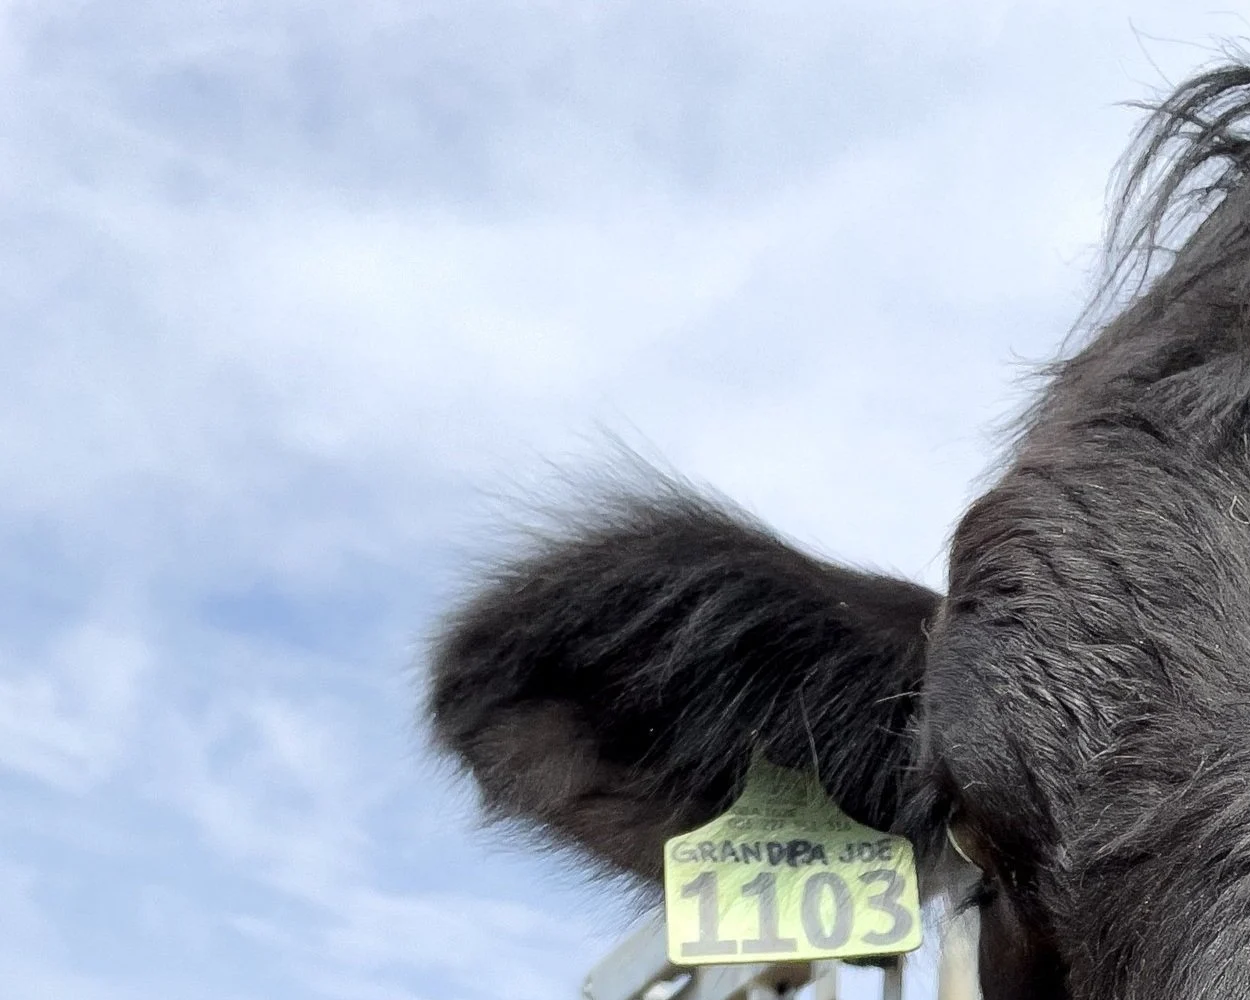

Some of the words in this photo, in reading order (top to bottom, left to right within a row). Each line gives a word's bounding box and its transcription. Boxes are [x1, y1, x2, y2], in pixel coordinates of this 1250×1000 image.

[671, 838, 828, 867] GRANDPA
[838, 838, 892, 863] JOE
[680, 869, 913, 957] 1103
